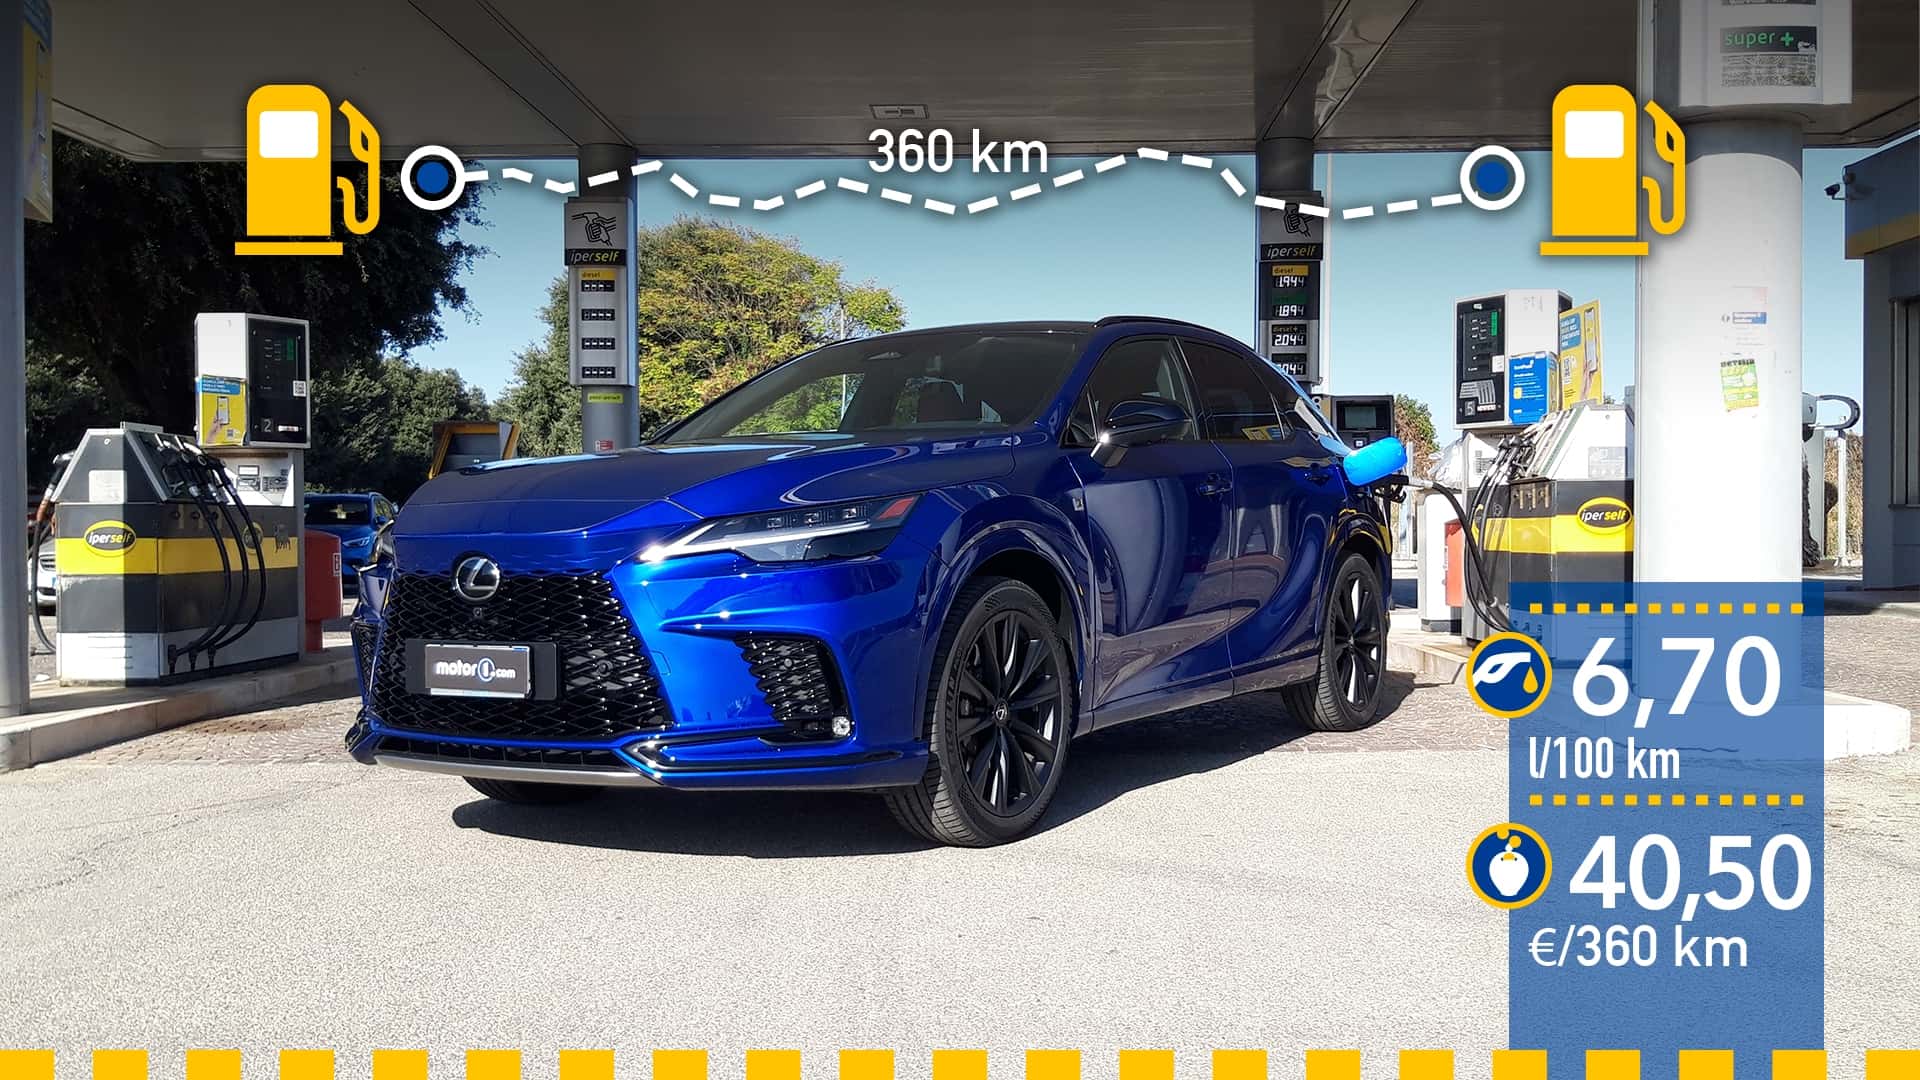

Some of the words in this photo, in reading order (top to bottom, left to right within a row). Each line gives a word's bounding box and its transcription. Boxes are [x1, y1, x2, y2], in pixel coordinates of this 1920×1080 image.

[1724, 31, 1776, 48] super
[570, 250, 620, 264] iperself
[1267, 245, 1316, 259] iperself
[1466, 401, 1474, 415] 5
[264, 419, 272, 432] 2
[1581, 508, 1627, 522] iperself
[88, 531, 132, 546] iperself
[435, 658, 516, 682] motor1.com
